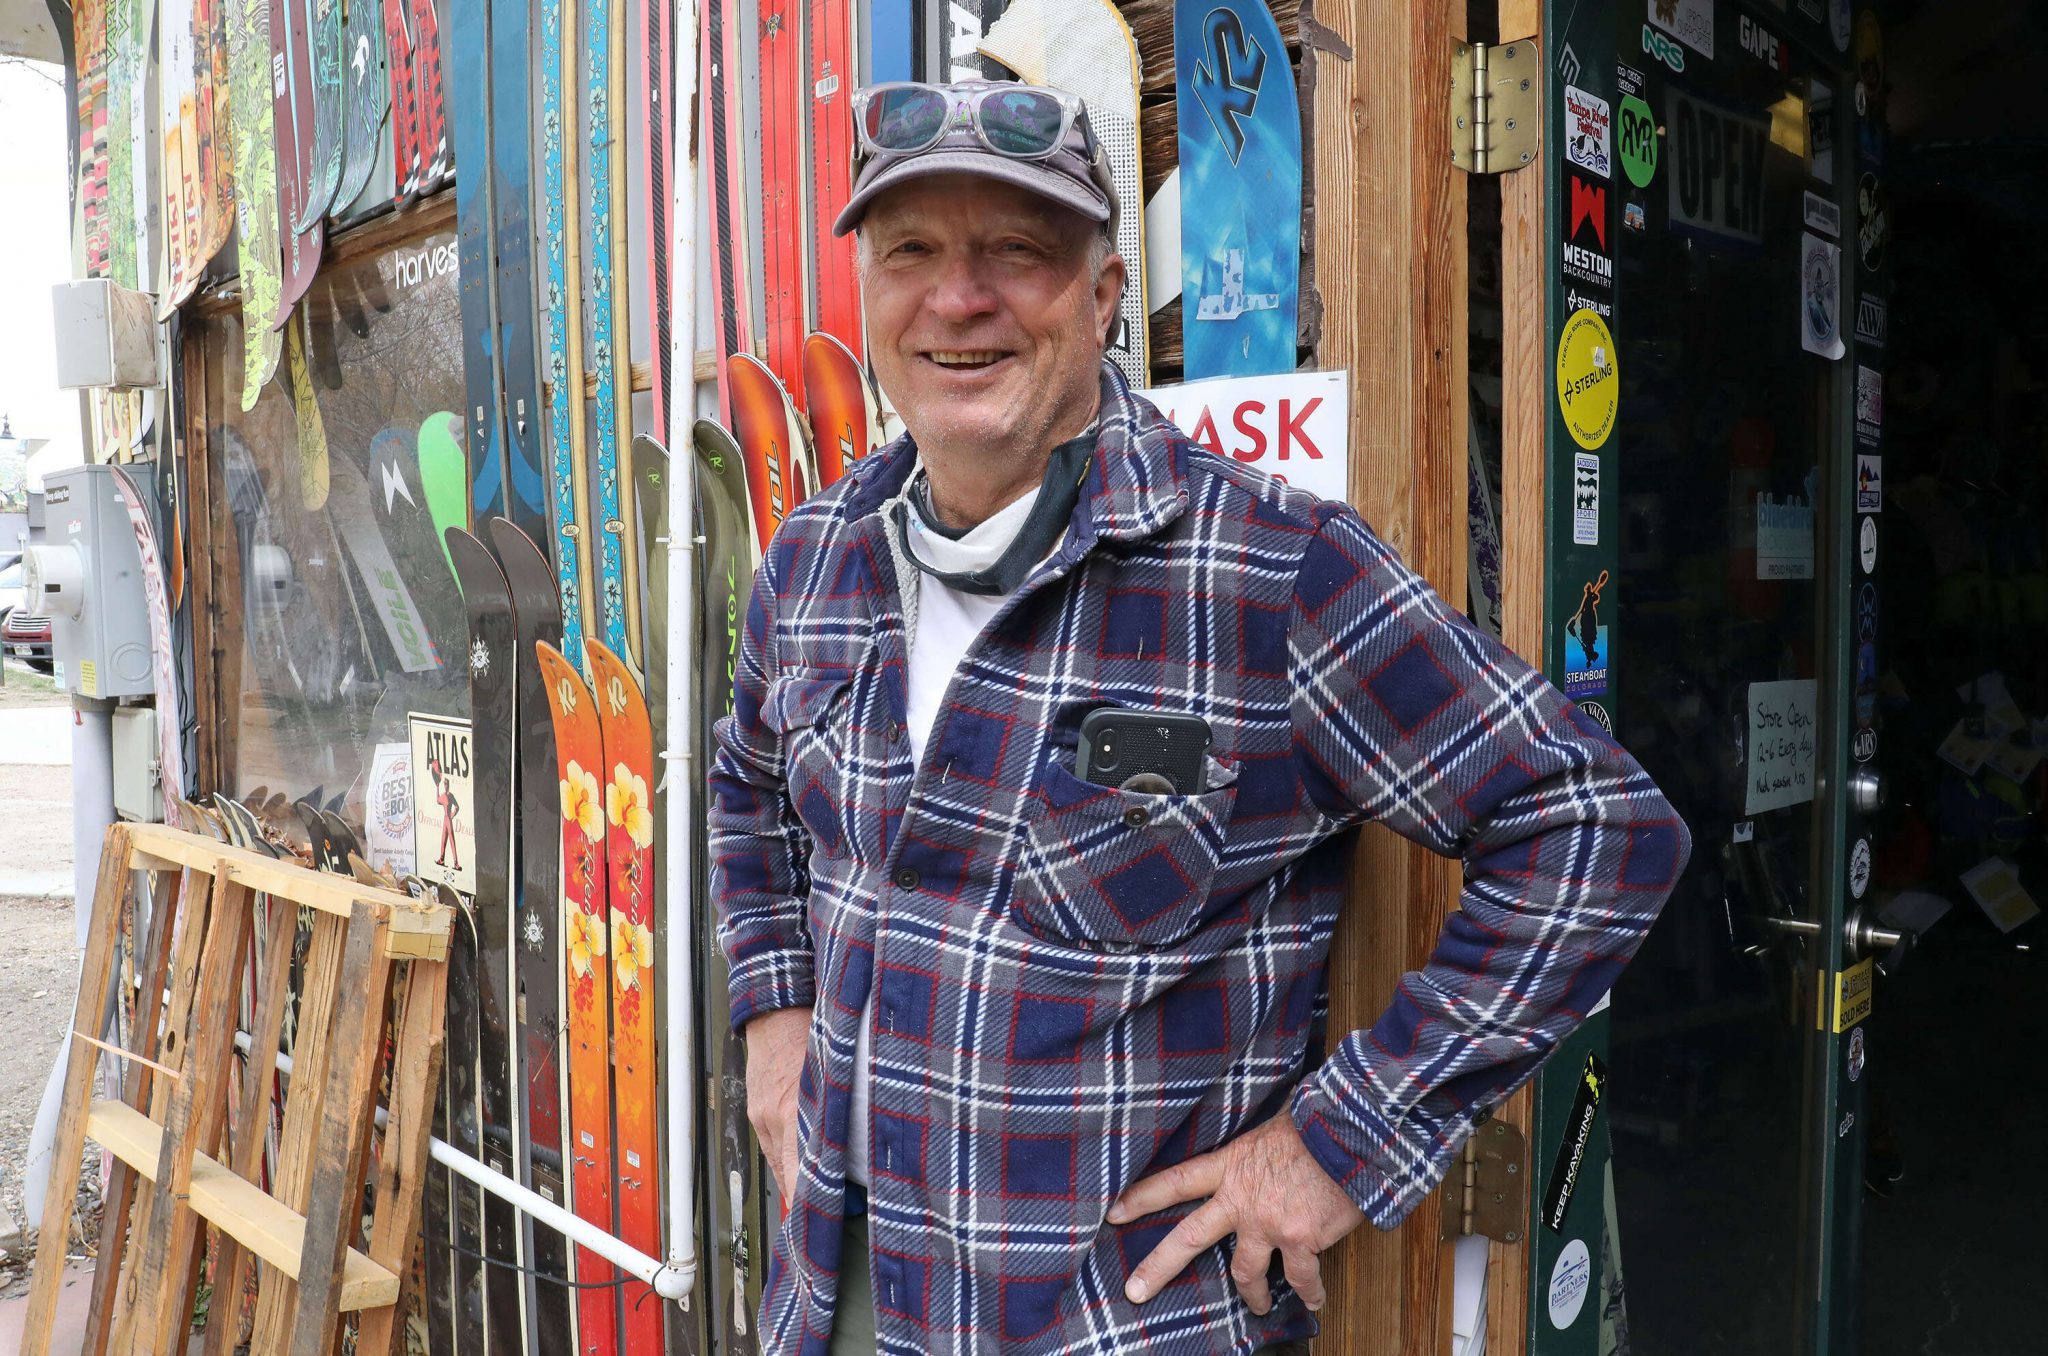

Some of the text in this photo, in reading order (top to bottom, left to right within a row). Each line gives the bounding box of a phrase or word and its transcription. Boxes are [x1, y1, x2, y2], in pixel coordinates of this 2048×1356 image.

[1643, 24, 1684, 72] NRS
[1567, 96, 1591, 121] Yampa
[1592, 107, 1609, 128] River
[1577, 117, 1603, 140] Festival
[1677, 97, 1765, 235] OPEN
[1563, 241, 1613, 278] WESTON
[1563, 263, 1612, 288] BACKCOUNTRY
[1577, 296, 1611, 317] STERLING
[1561, 331, 1574, 369] STERLING
[1574, 362, 1613, 395] STERLING
[1168, 397, 1324, 463] ASK
[1573, 400, 1615, 441] AUTHORIZED DEALER
[1566, 668, 1608, 685] STEAMBOAT
[1566, 680, 1608, 693] COLORADO
[1757, 702, 1812, 735] Store Open
[426, 730, 469, 779] ATLAS
[382, 774, 412, 802] BEST
[1552, 1183, 1569, 1230] KEEP
[1565, 1103, 1593, 1184] KAYAKING
[1551, 1269, 1589, 1299] PARTNERS
